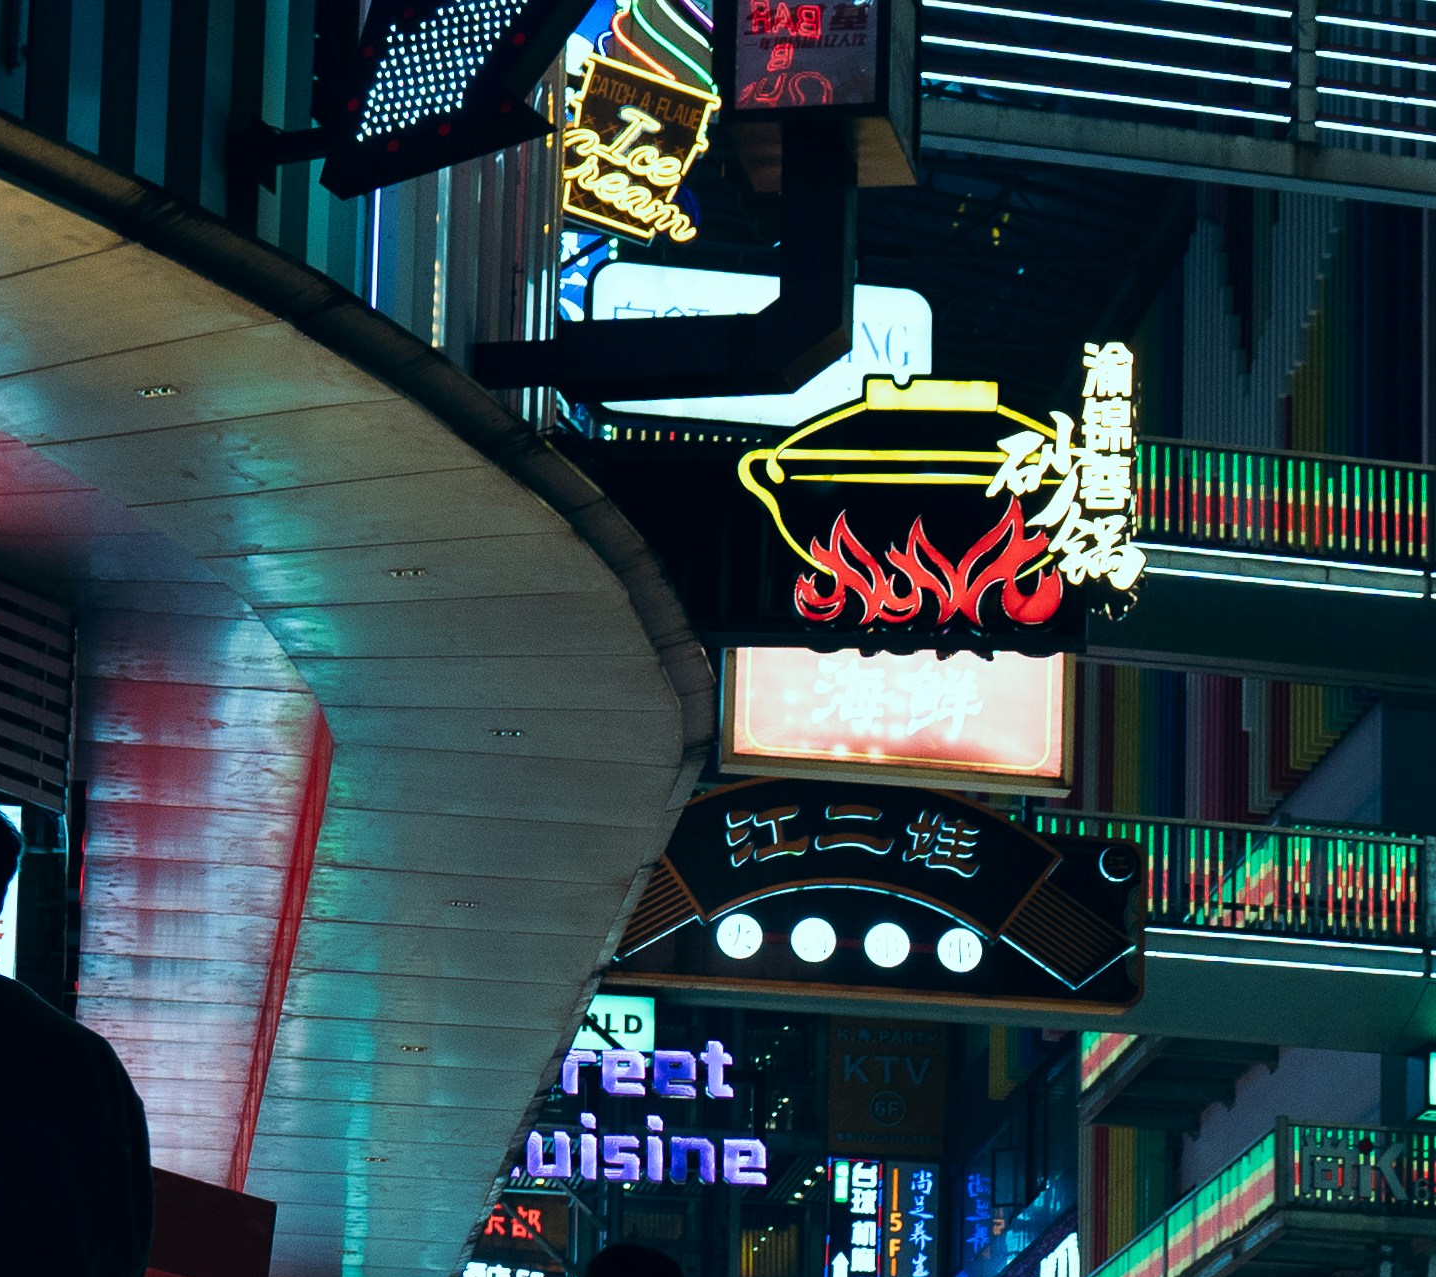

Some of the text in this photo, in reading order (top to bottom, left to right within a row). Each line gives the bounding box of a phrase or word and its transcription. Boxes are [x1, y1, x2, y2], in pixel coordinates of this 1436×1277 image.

[562, 155, 698, 244] ream
[811, 657, 985, 741] 海鲜
[841, 1052, 933, 1086] KTV
[510, 1112, 768, 1186] uisine
